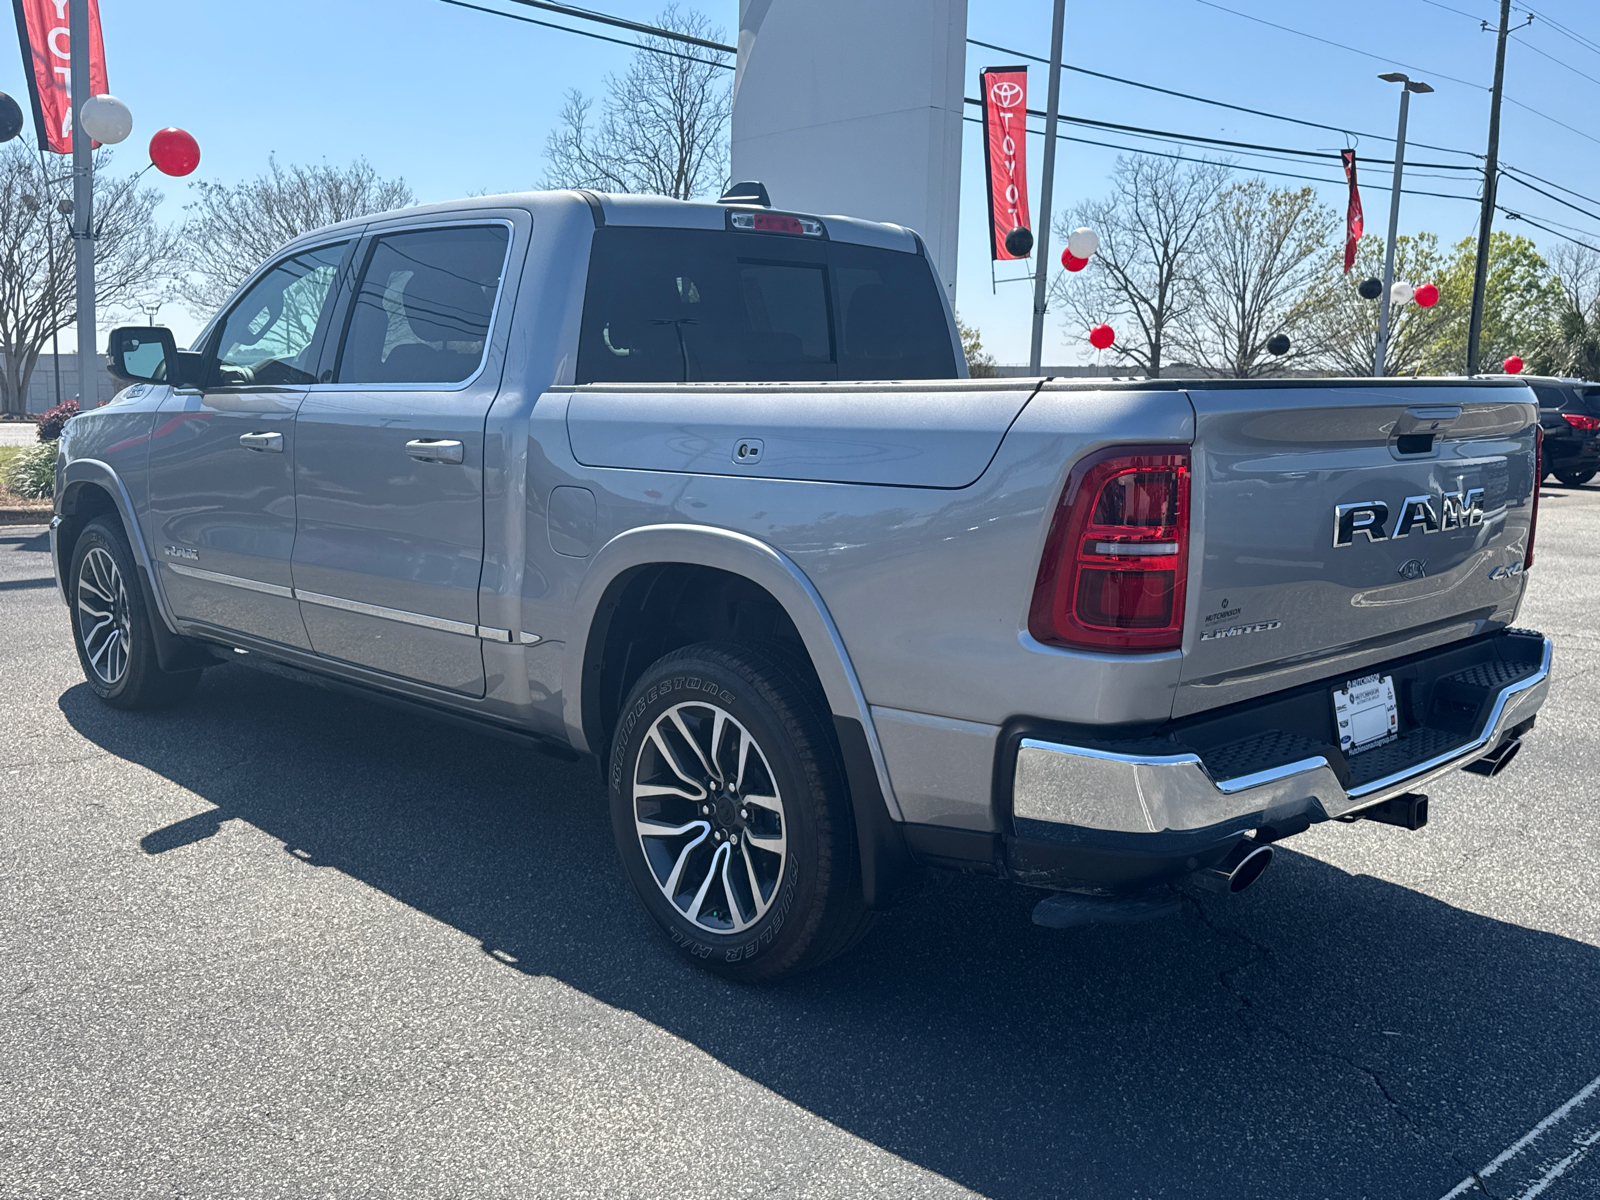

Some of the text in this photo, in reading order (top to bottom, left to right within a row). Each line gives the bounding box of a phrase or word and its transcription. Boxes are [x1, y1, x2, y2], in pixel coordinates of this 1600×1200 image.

[999, 112, 1020, 229] TOYOT
[1333, 487, 1485, 548] RAM
[1200, 619, 1282, 641] LIMITED
[1205, 607, 1242, 623] HUTCHINSON
[612, 676, 736, 794] BRIDGESTONE
[669, 852, 799, 962] DUELER H/L
